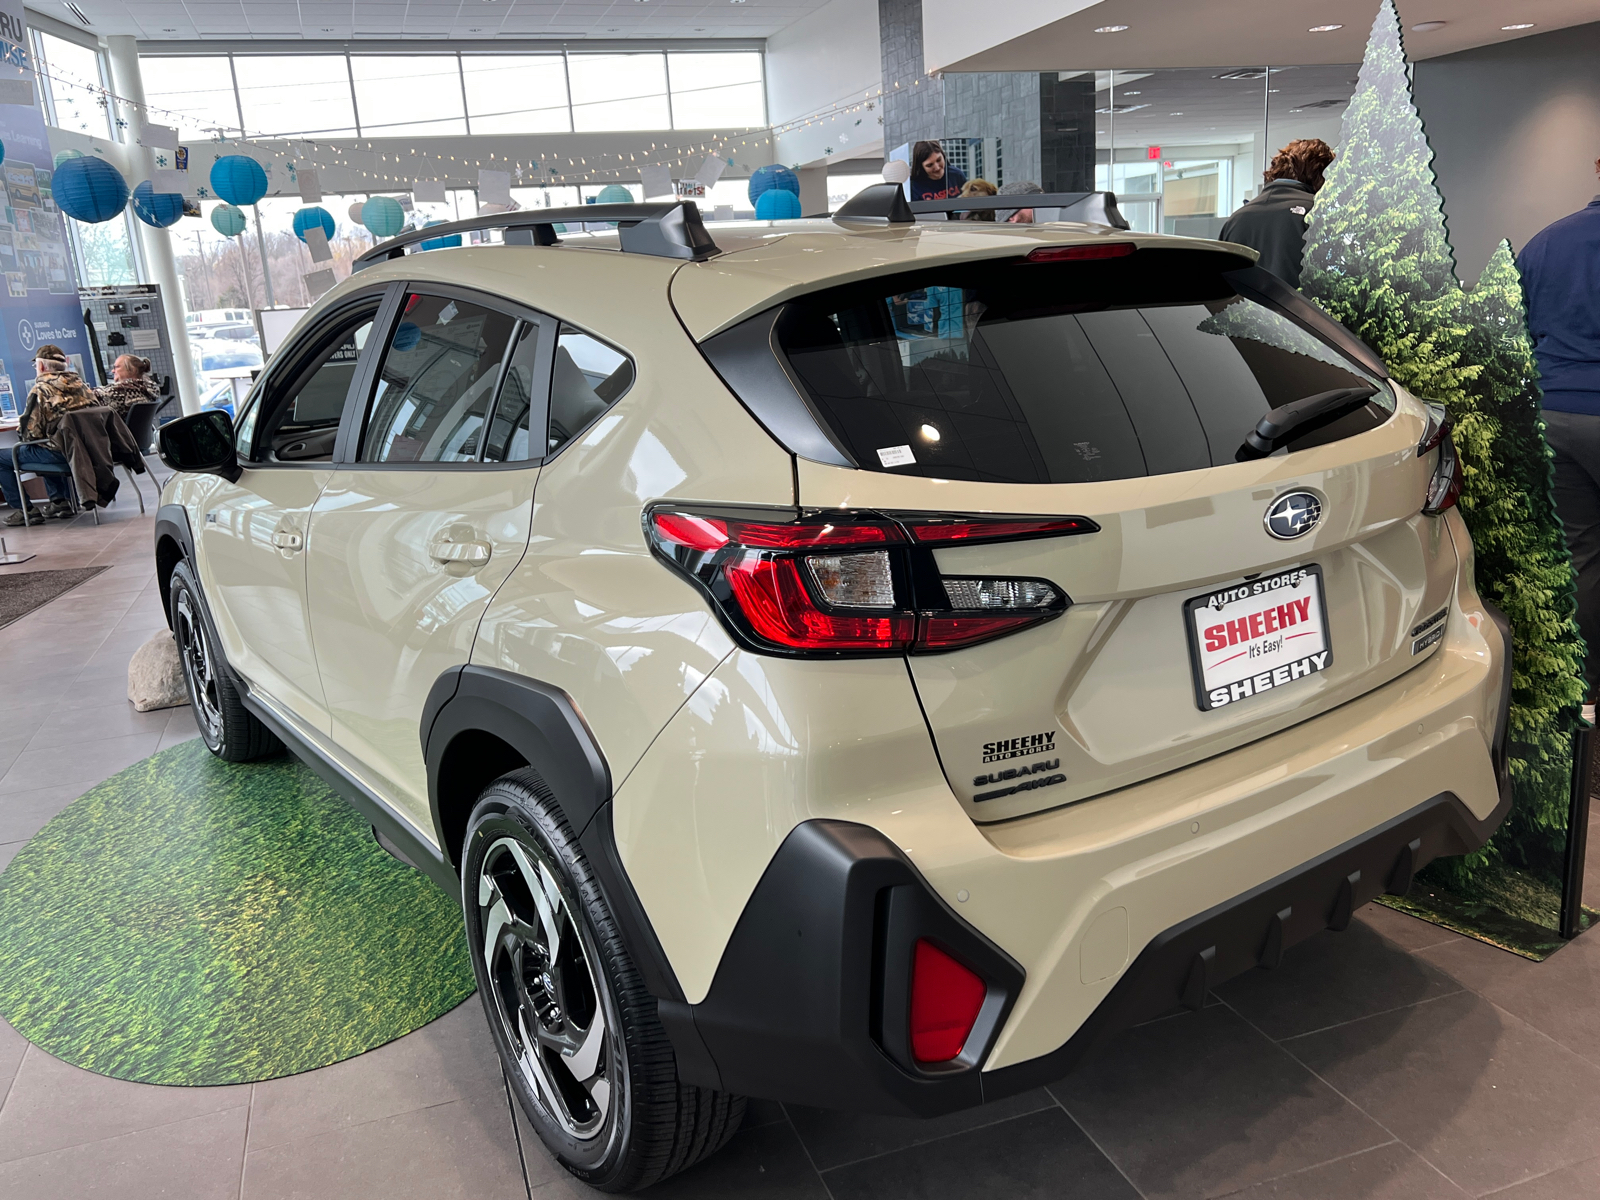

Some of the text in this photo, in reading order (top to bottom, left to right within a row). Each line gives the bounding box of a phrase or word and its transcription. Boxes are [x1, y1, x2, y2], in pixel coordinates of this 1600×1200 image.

[0, 12, 23, 43] RU
[36, 327, 76, 340] Loves to Care
[344, 350, 356, 358] ONLY
[1206, 568, 1309, 608] AUTO STORES
[1204, 596, 1312, 653] SHEEHY
[1248, 636, 1284, 660] It's Easy!
[1209, 650, 1329, 708] SHEEHY
[982, 730, 1056, 756] SHEEHY
[984, 743, 1054, 763] AUTO STORES
[973, 758, 1060, 787] SUBARU
[1009, 773, 1067, 793] AWD
